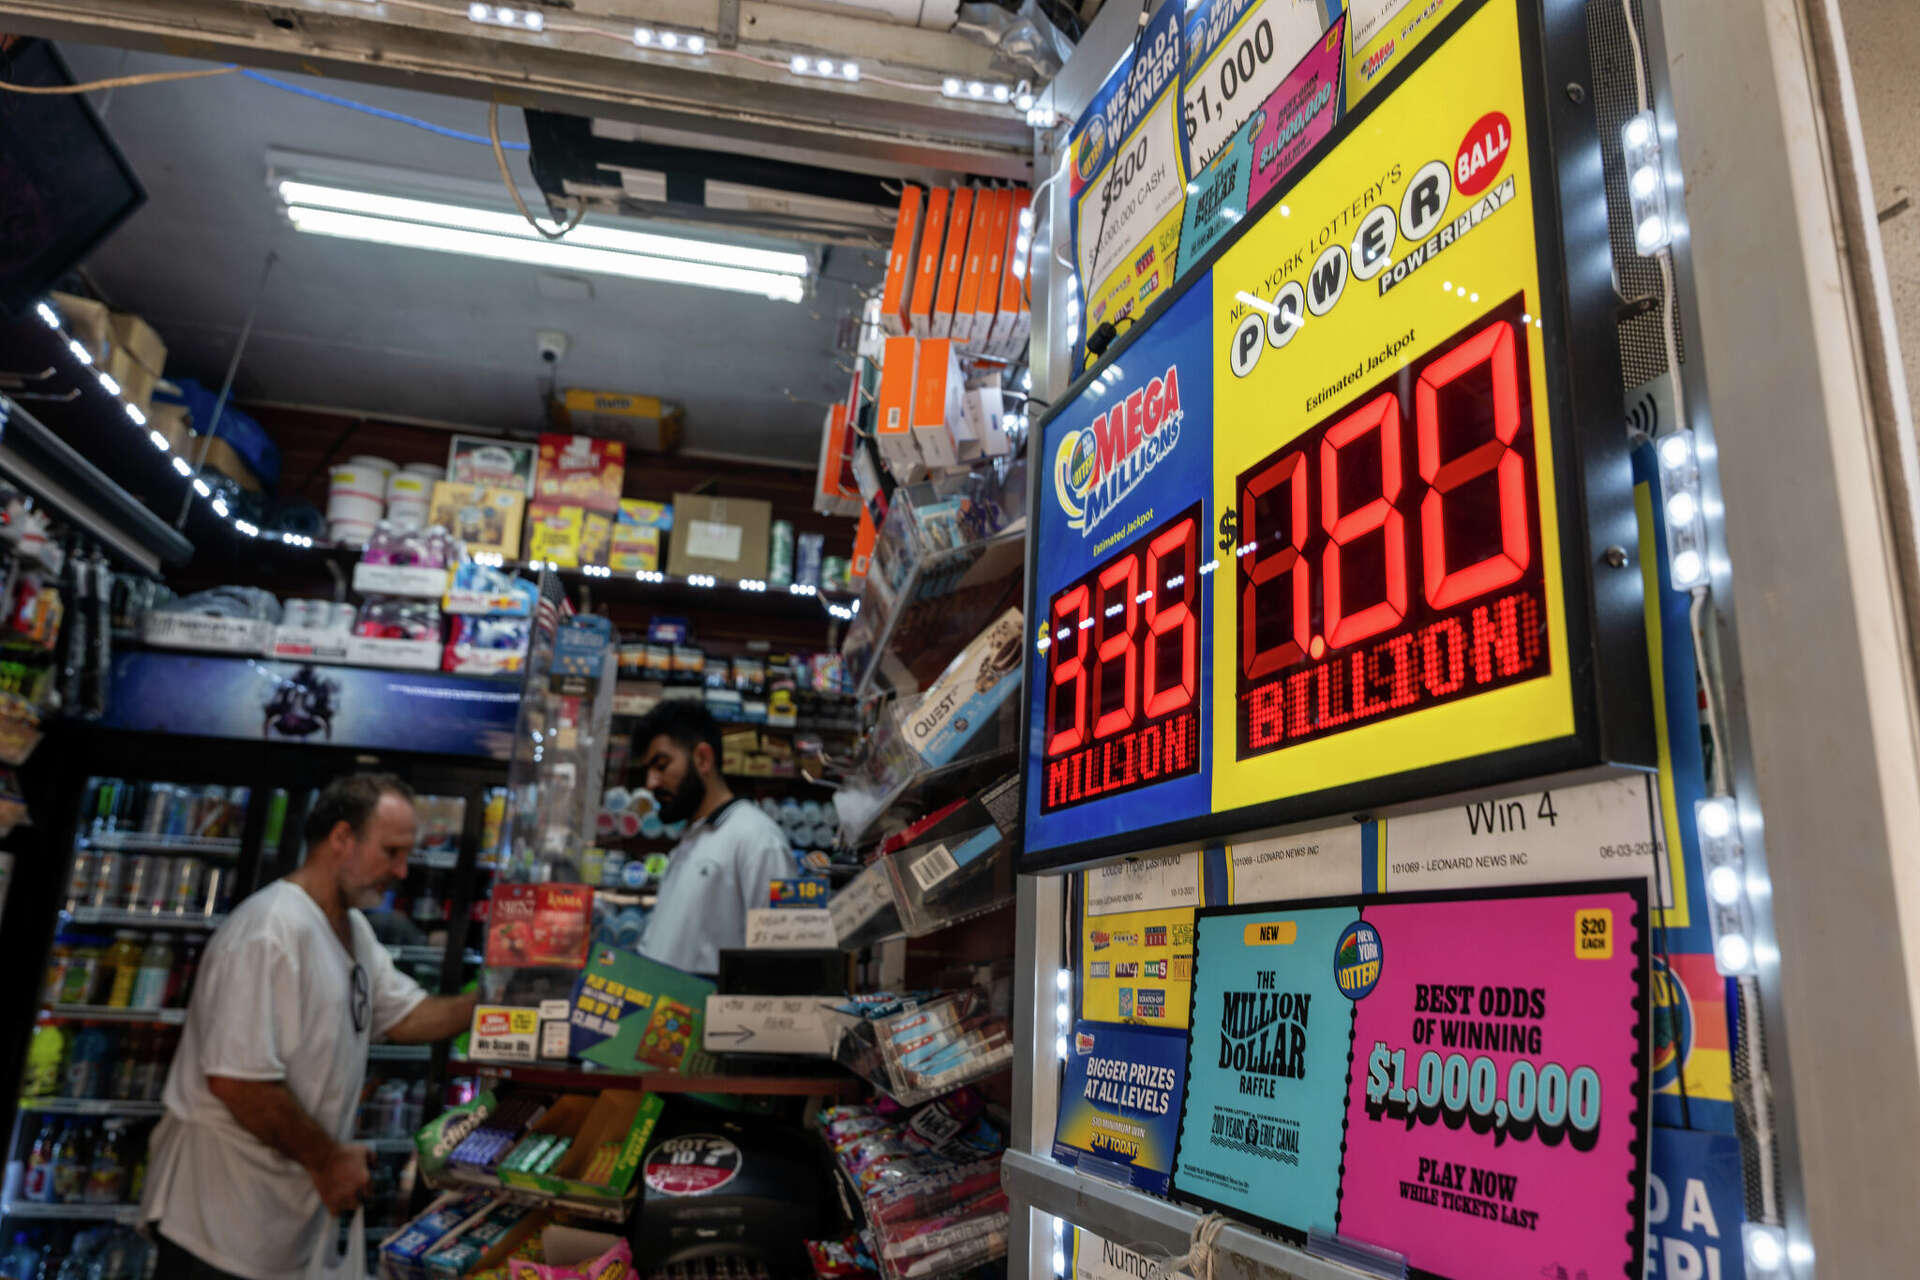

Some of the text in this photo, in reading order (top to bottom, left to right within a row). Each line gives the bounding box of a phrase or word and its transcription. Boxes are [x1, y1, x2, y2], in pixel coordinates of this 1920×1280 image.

[1107, 14, 1179, 122] WE SOLD A
[1184, 19, 1274, 144] $1,000
[1107, 36, 1179, 149] WINNER!
[1100, 135, 1148, 217] $500
[1137, 162, 1166, 205] CASH
[1233, 123, 1510, 372] POWER BALL
[1264, 251, 1304, 292] YORK
[1309, 163, 1402, 254] LOTTERY'S
[1305, 328, 1416, 412] Estimated Jackpot
[1090, 365, 1179, 491] MEGA
[1093, 508, 1154, 557] Estimated Jackpot
[1249, 596, 1521, 748] BILLION
[914, 694, 955, 738] QUEST
[1048, 715, 1190, 807] MILLION
[1465, 791, 1558, 836] Win 4
[1256, 852, 1285, 865] LEONARD
[1286, 848, 1306, 860] NEWS
[1307, 845, 1319, 856] INC
[1391, 853, 1528, 874] 101069 LEONARD NEWS INC
[1259, 926, 1280, 941] NEW
[1357, 930, 1374, 944] NEW
[1580, 917, 1606, 936] $20
[1581, 936, 1606, 950] EACH
[1358, 943, 1379, 962] YORK
[1257, 971, 1276, 989] THE
[1338, 960, 1380, 991] LOTTERY
[1221, 991, 1311, 1039] MILLION
[1414, 983, 1546, 1019] BEST ODDS
[1218, 1022, 1307, 1081] DOLLAR
[1412, 1018, 1542, 1055] OF WINNING
[1086, 1056, 1176, 1091] BIGGER PRIZES
[1239, 1075, 1277, 1099] RAFFLE
[1366, 1042, 1601, 1142] $1,000,000
[1083, 1078, 1170, 1115] AT ALL LEVELS
[662, 1139, 706, 1154] GOT
[1090, 1133, 1140, 1157] PLAY TODAY!
[1102, 1118, 1131, 1134] MINIMUM
[1131, 1124, 1145, 1139] WIN
[1211, 1113, 1245, 1141] 200 YEARS
[1260, 1123, 1300, 1153] ERIE CANAL
[670, 1151, 697, 1166] ID
[1418, 1157, 1518, 1203] PLAY NOW
[1399, 1181, 1540, 1231] WHILE TICKETS LAST
[1681, 1178, 1721, 1238] A
